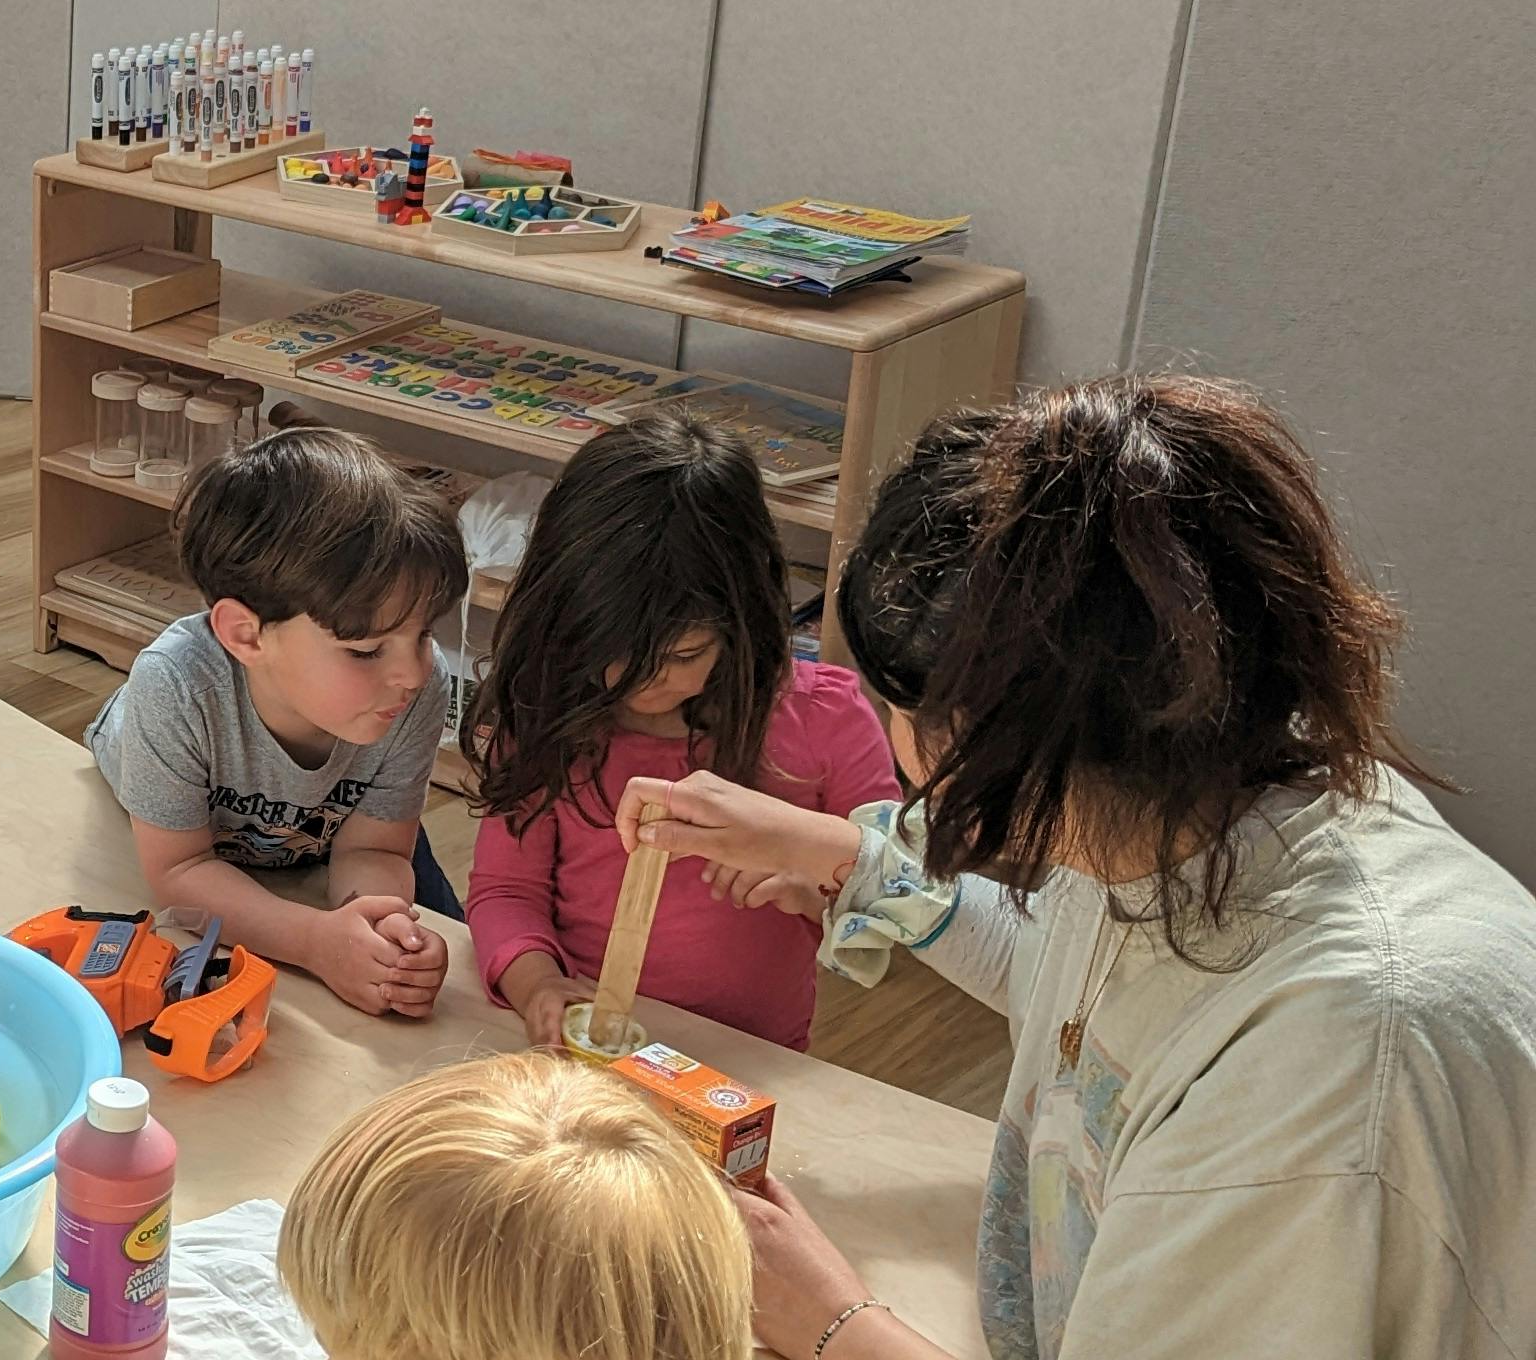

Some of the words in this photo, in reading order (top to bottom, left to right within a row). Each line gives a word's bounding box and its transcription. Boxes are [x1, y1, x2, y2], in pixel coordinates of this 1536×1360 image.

[137, 1214, 170, 1243] Cray
[130, 1273, 169, 1304] TEMP
[132, 1264, 169, 1287] wash
